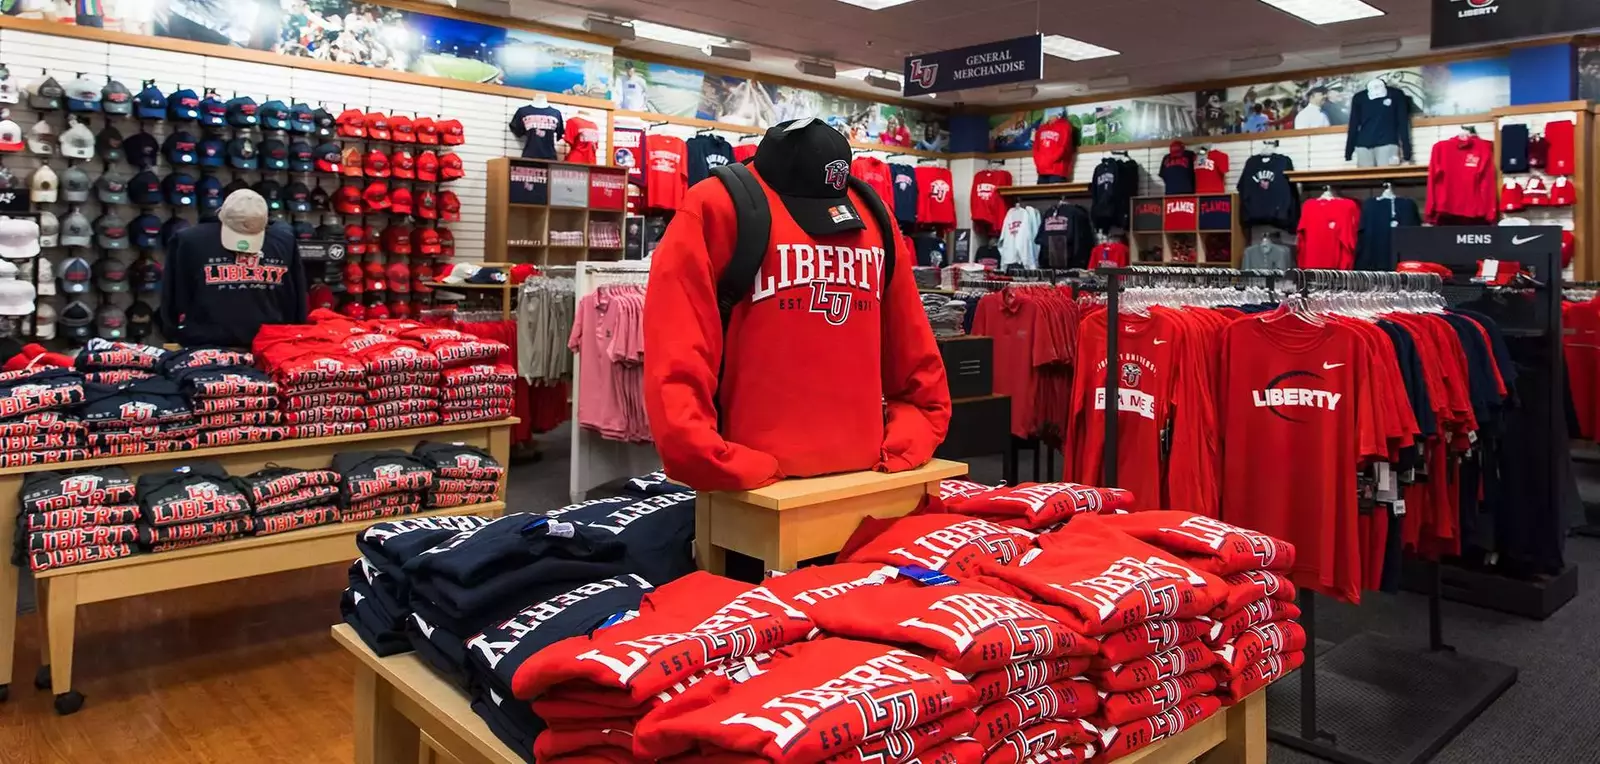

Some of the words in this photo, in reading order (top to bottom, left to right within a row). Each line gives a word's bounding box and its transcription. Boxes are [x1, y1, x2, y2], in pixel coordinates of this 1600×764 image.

[1458, 5, 1499, 18] LIBERTY
[966, 50, 1012, 66] GENERAL
[953, 61, 1026, 80] MERCHANDISE
[1167, 202, 1195, 214] FLAMES
[1457, 234, 1491, 245] MENS
[204, 265, 288, 284] LIBERTY
[752, 243, 886, 303] LIBERTY
[780, 299, 805, 311] EST.
[809, 278, 853, 326] LU
[1097, 392, 1154, 414] FAMES
[1252, 388, 1342, 411] LIBERTY
[28, 505, 141, 532] LIBERTY
[29, 524, 139, 553] LIBERTY
[981, 641, 1009, 661] EST.
[661, 649, 700, 678] EST.
[820, 723, 860, 751] EST.
[845, 688, 920, 742] LU
[1126, 729, 1152, 750] EST.
